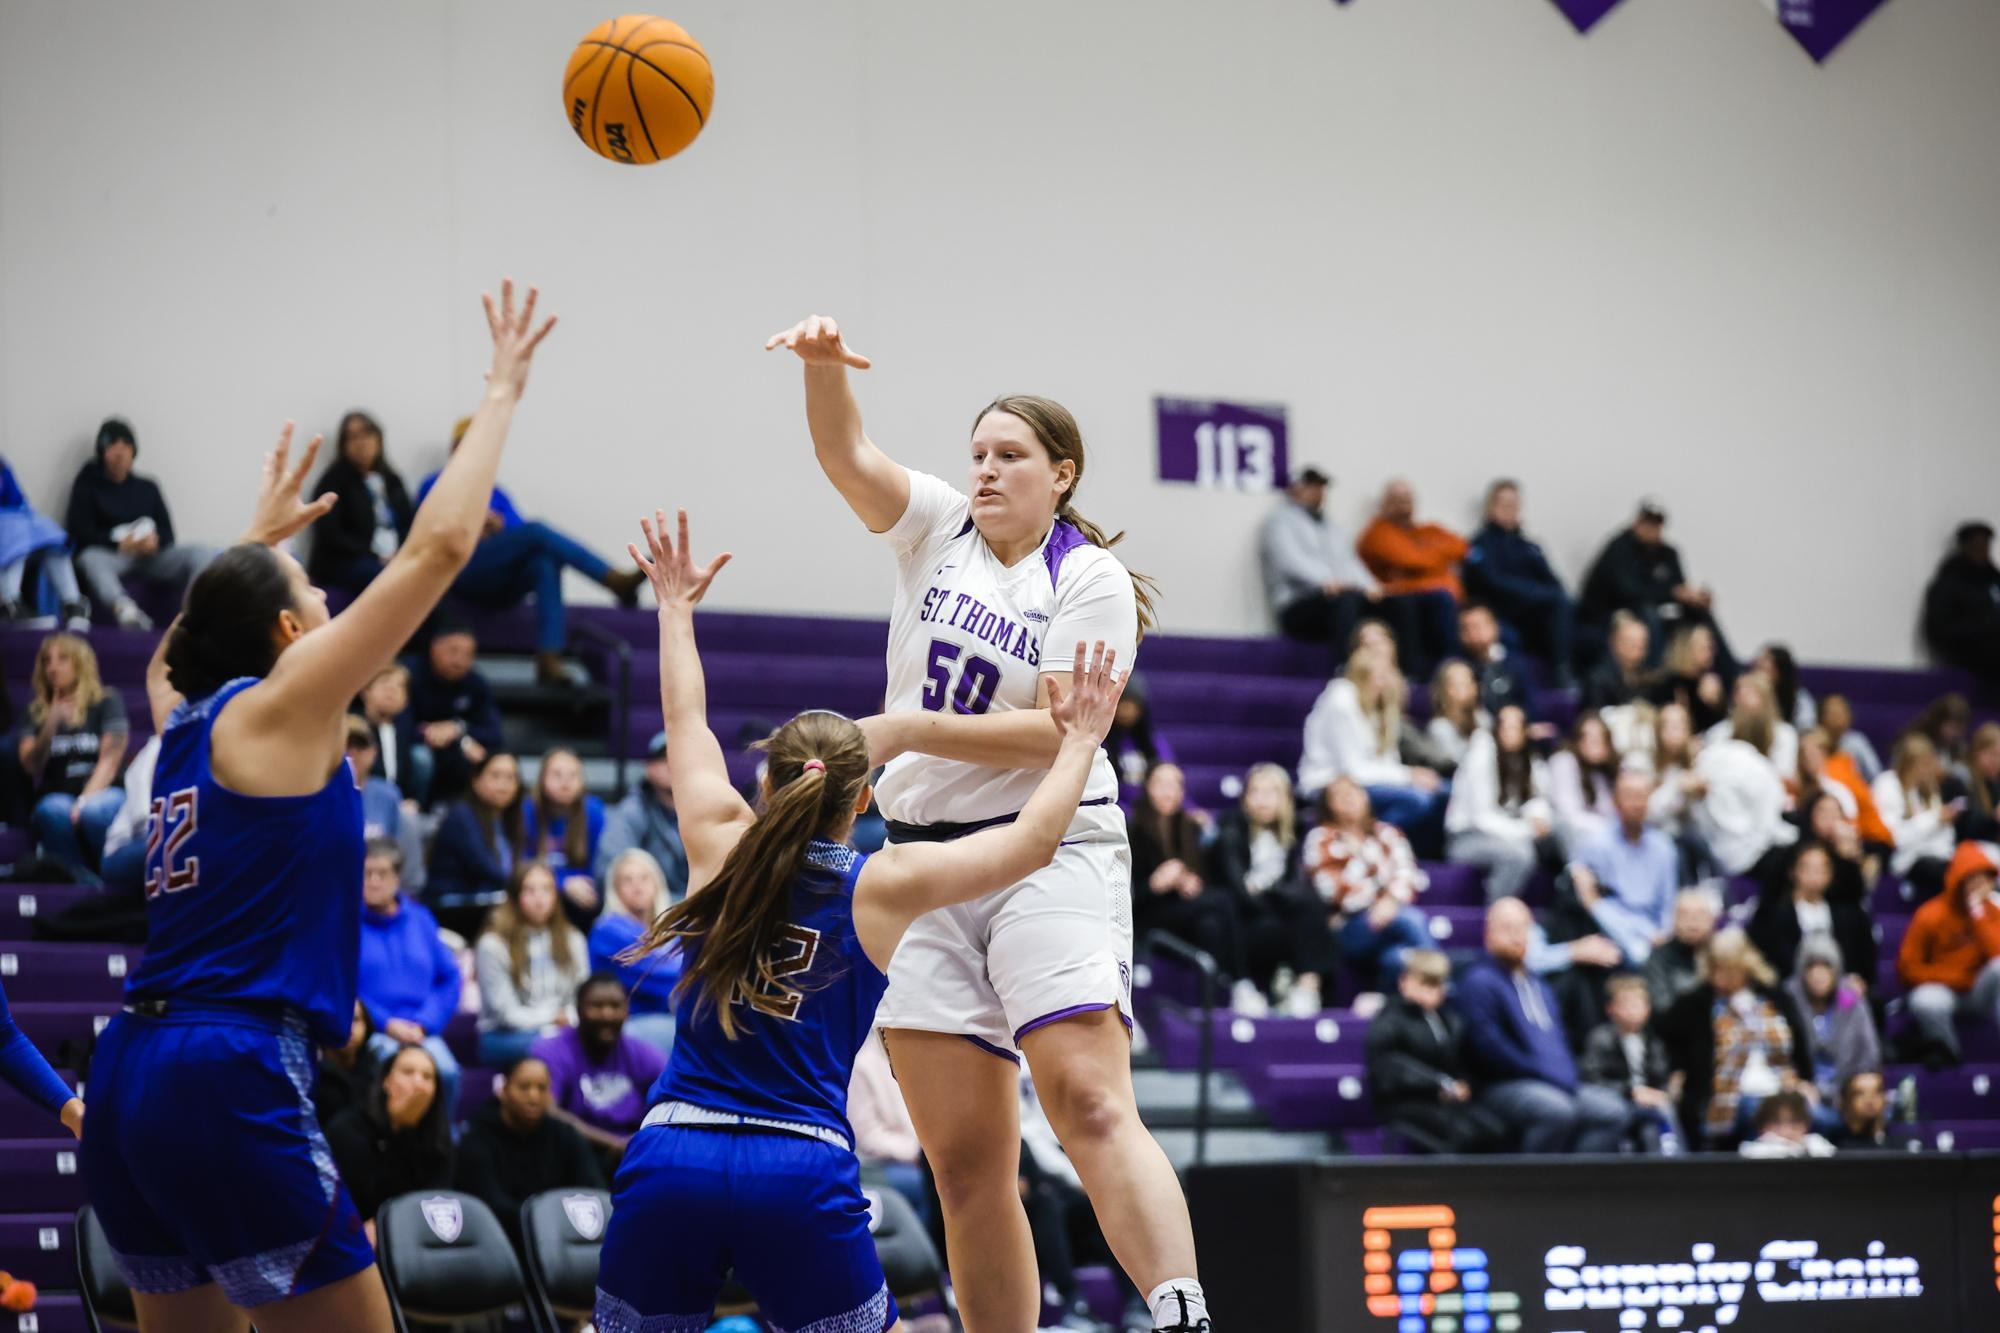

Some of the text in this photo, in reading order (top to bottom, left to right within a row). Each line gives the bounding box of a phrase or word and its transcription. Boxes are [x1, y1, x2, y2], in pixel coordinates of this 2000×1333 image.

[604, 122, 637, 164] CAA
[1194, 420, 1275, 490] 113
[922, 637, 1003, 714] 50
[144, 785, 199, 900] 22
[1544, 1240, 1924, 1327] Supply Chain
